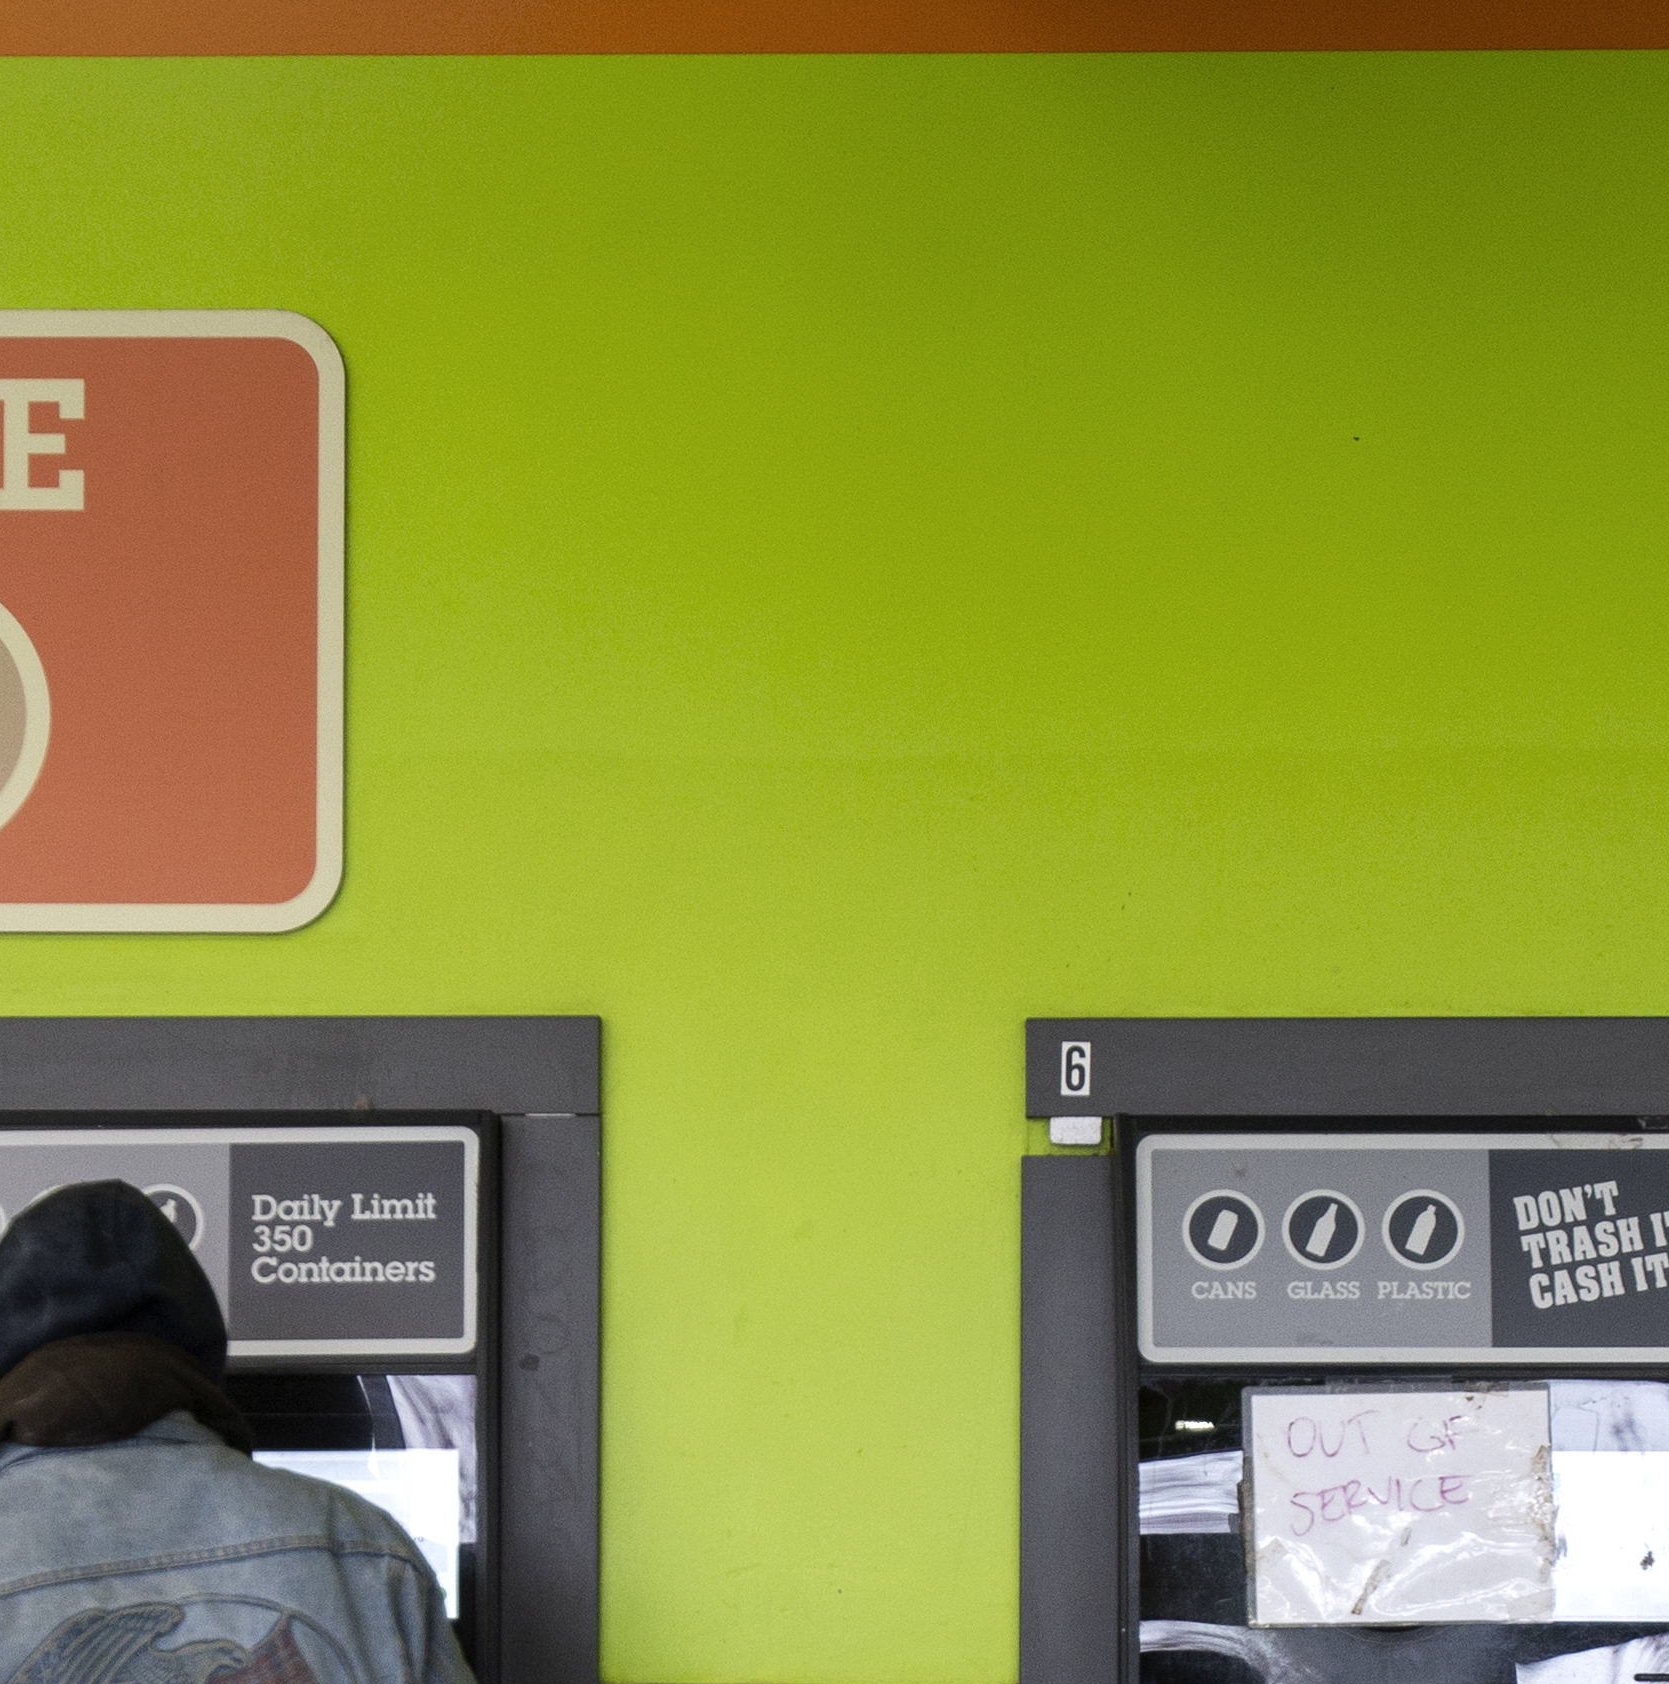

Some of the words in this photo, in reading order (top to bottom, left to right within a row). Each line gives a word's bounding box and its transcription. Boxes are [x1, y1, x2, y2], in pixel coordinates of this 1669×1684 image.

[1065, 1044, 1086, 1092] 6
[250, 1193, 344, 1228] Daily
[350, 1192, 438, 1221] Limit
[1512, 1179, 1620, 1232] DON'T
[251, 1224, 314, 1253] 350
[1519, 1215, 1645, 1270] TRASH
[250, 1254, 437, 1285] Containers
[1191, 1280, 1258, 1300] CANS
[1287, 1280, 1361, 1300] GLASS
[1377, 1280, 1472, 1300] PLASTIC
[1528, 1259, 1627, 1311] CASH
[1286, 1409, 1381, 1458] OUT
[1289, 1474, 1474, 1538] SERVICE
